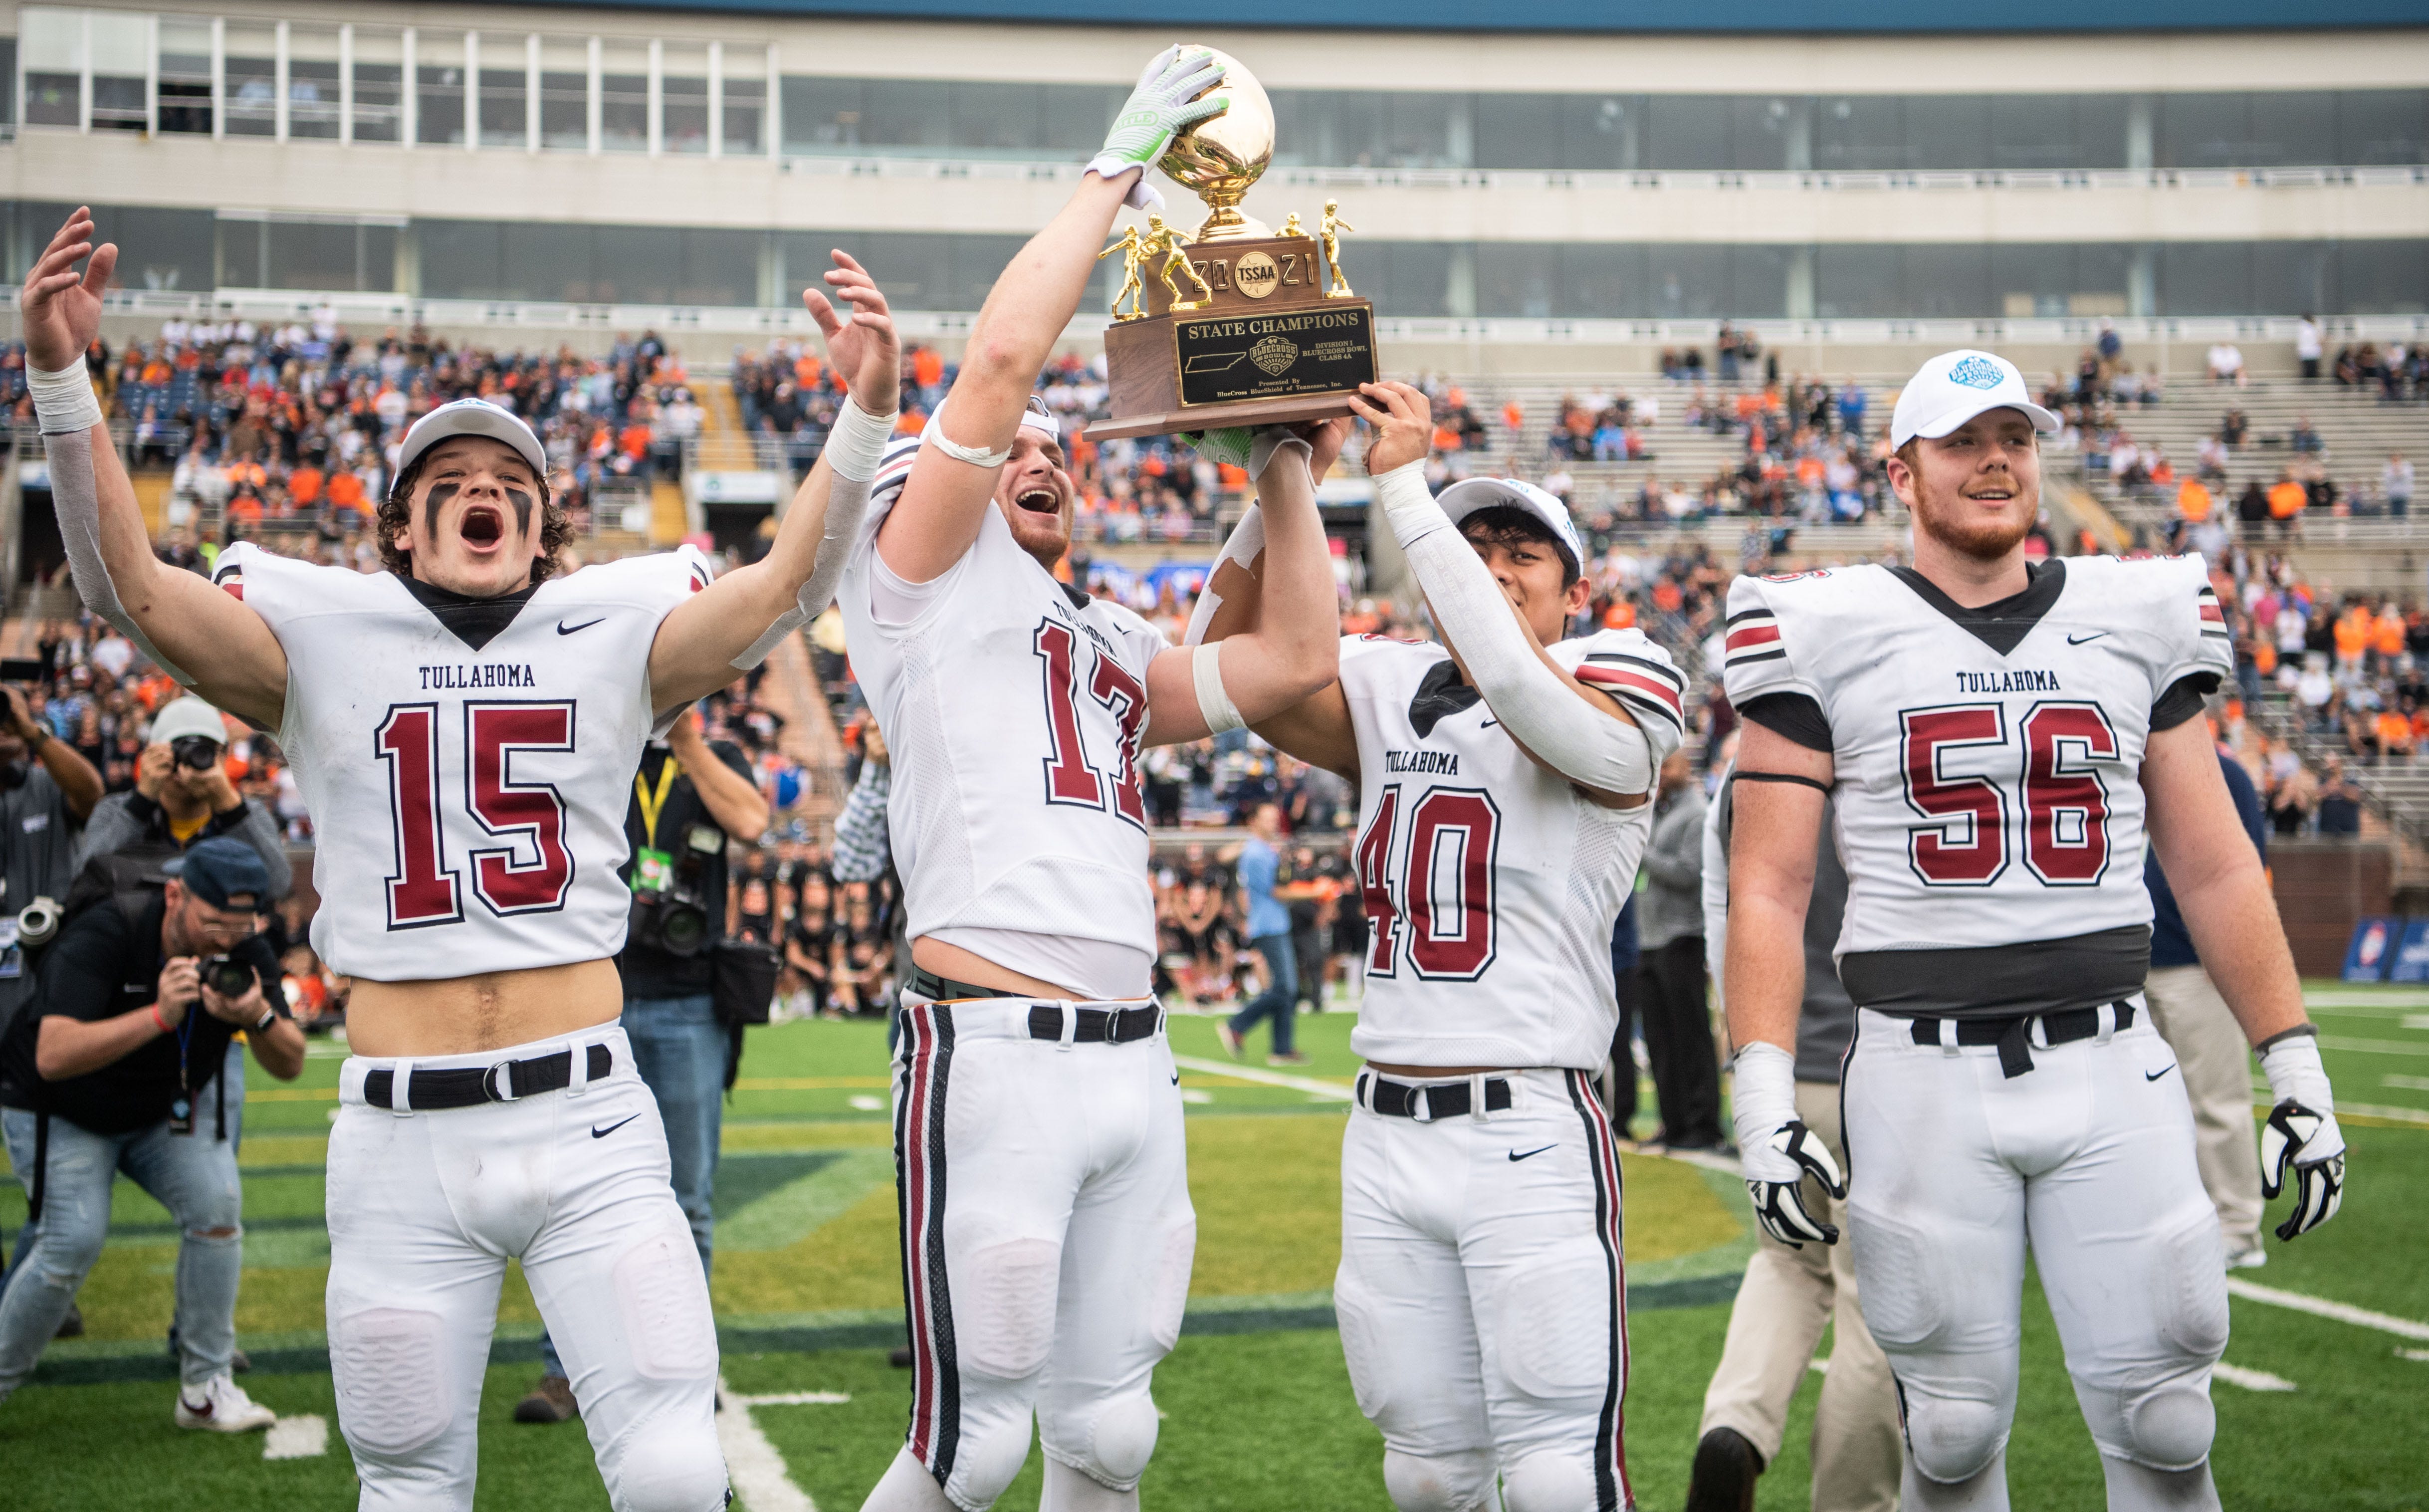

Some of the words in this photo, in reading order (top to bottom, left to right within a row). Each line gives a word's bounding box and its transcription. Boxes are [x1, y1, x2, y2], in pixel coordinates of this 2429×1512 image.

[1192, 259, 1230, 291] 20
[1238, 266, 1275, 281] TSSAA
[1281, 253, 1314, 285] 21
[1189, 322, 1245, 339] STATE
[1249, 312, 1359, 334] CHAMPIONS
[1252, 344, 1296, 358] BLUECROSS
[1302, 347, 1345, 356] BLUECROSS
[1951, 361, 2003, 380] BLUECROSS
[1052, 600, 1117, 657] TULLAHOMA
[419, 664, 535, 689] TULLAHOMA
[1956, 670, 2061, 692] TULLAHOMA
[1033, 616, 1147, 837] 17
[1385, 750, 1459, 776] TULLAHOMA
[1898, 700, 2121, 887] 56
[374, 698, 577, 931] 15
[1356, 783, 1502, 983] 40
